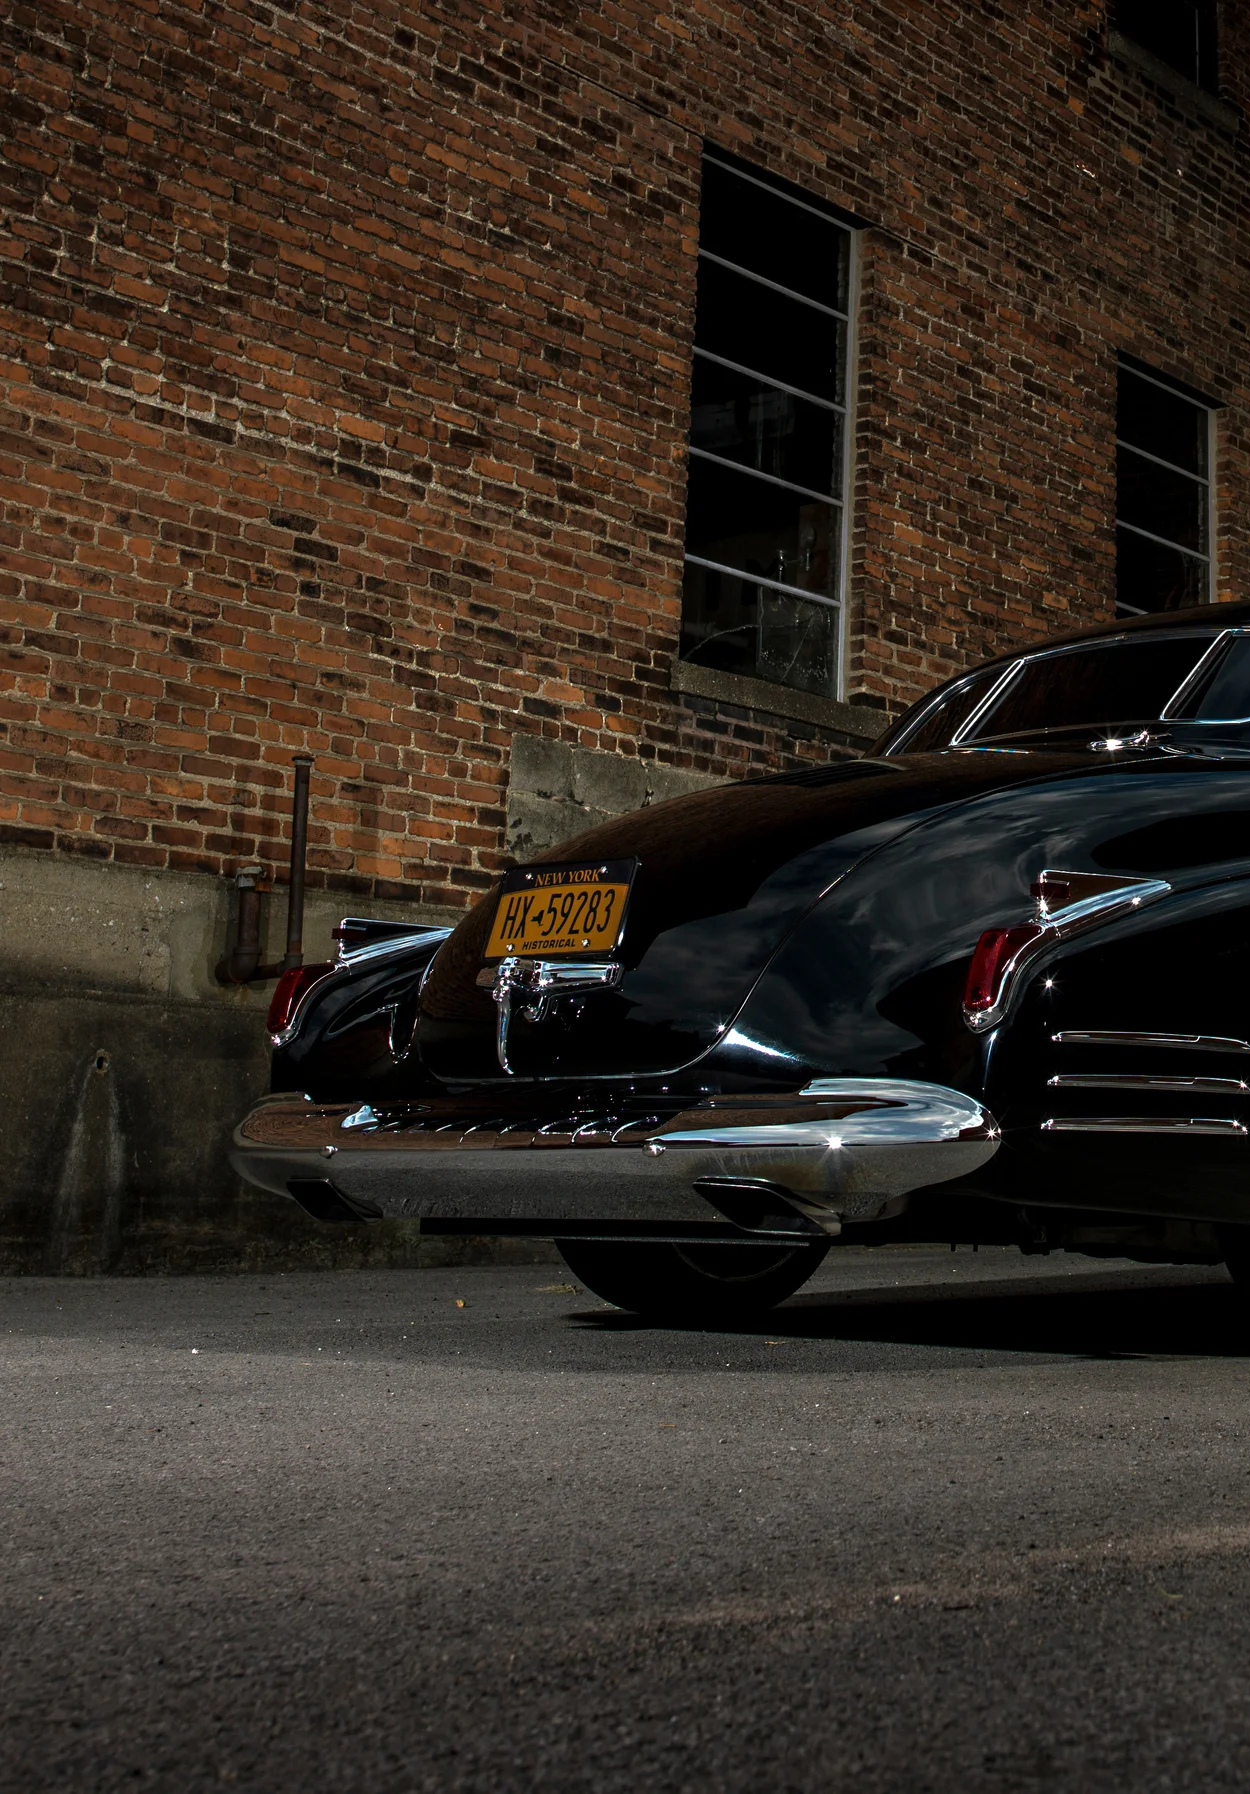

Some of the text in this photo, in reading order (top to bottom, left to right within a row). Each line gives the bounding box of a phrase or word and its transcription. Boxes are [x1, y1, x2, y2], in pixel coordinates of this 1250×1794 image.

[535, 869, 600, 886] NEW YORK
[523, 939, 576, 950] HISTORICAL
